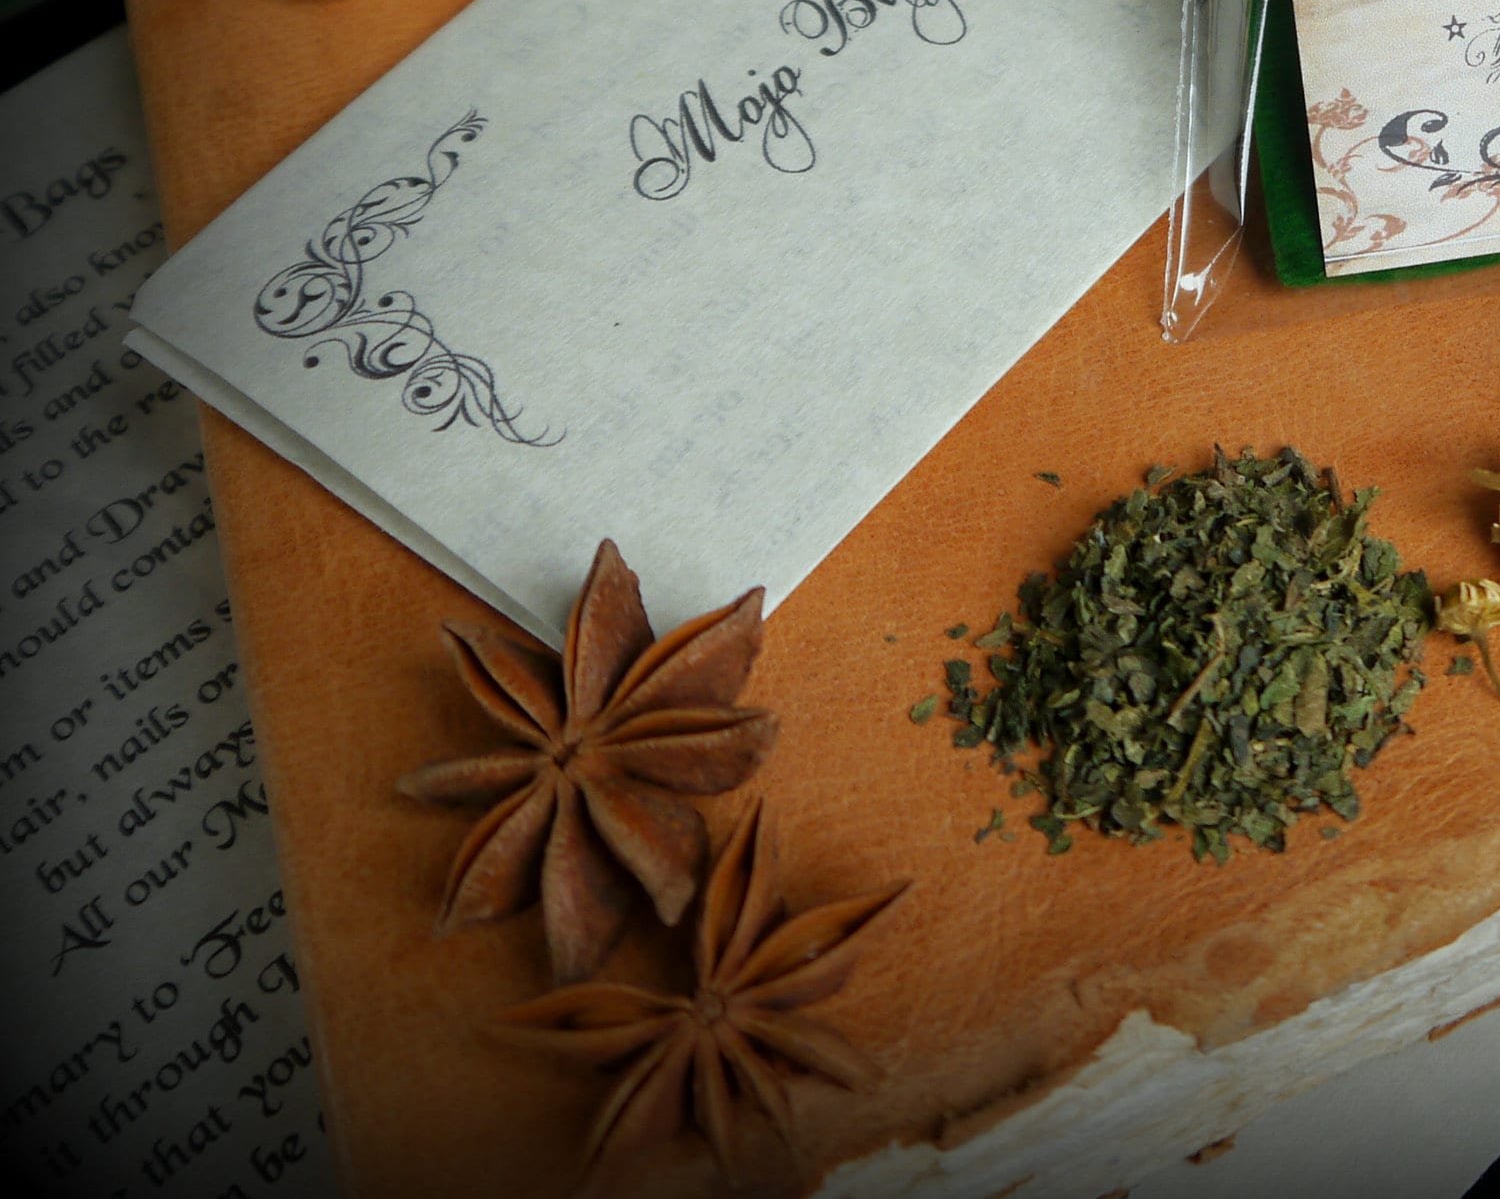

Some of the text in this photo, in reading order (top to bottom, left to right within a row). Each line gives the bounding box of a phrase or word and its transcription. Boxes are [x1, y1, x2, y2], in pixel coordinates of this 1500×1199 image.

[629, 64, 817, 201] Mojo
[0, 146, 130, 245] Bags
[16, 275, 87, 328] also
[12, 307, 109, 397] filled
[43, 360, 117, 422] and
[21, 458, 65, 492] to
[70, 413, 129, 460] the
[11, 529, 87, 600] and
[50, 617, 212, 742] or items
[91, 702, 191, 783] nails
[197, 662, 239, 705] or
[35, 833, 109, 894] but
[50, 840, 194, 978] All our
[131, 981, 180, 1024] to
[88, 996, 261, 1145] through
[141, 1105, 234, 1188] that
[248, 1132, 309, 1184] be
